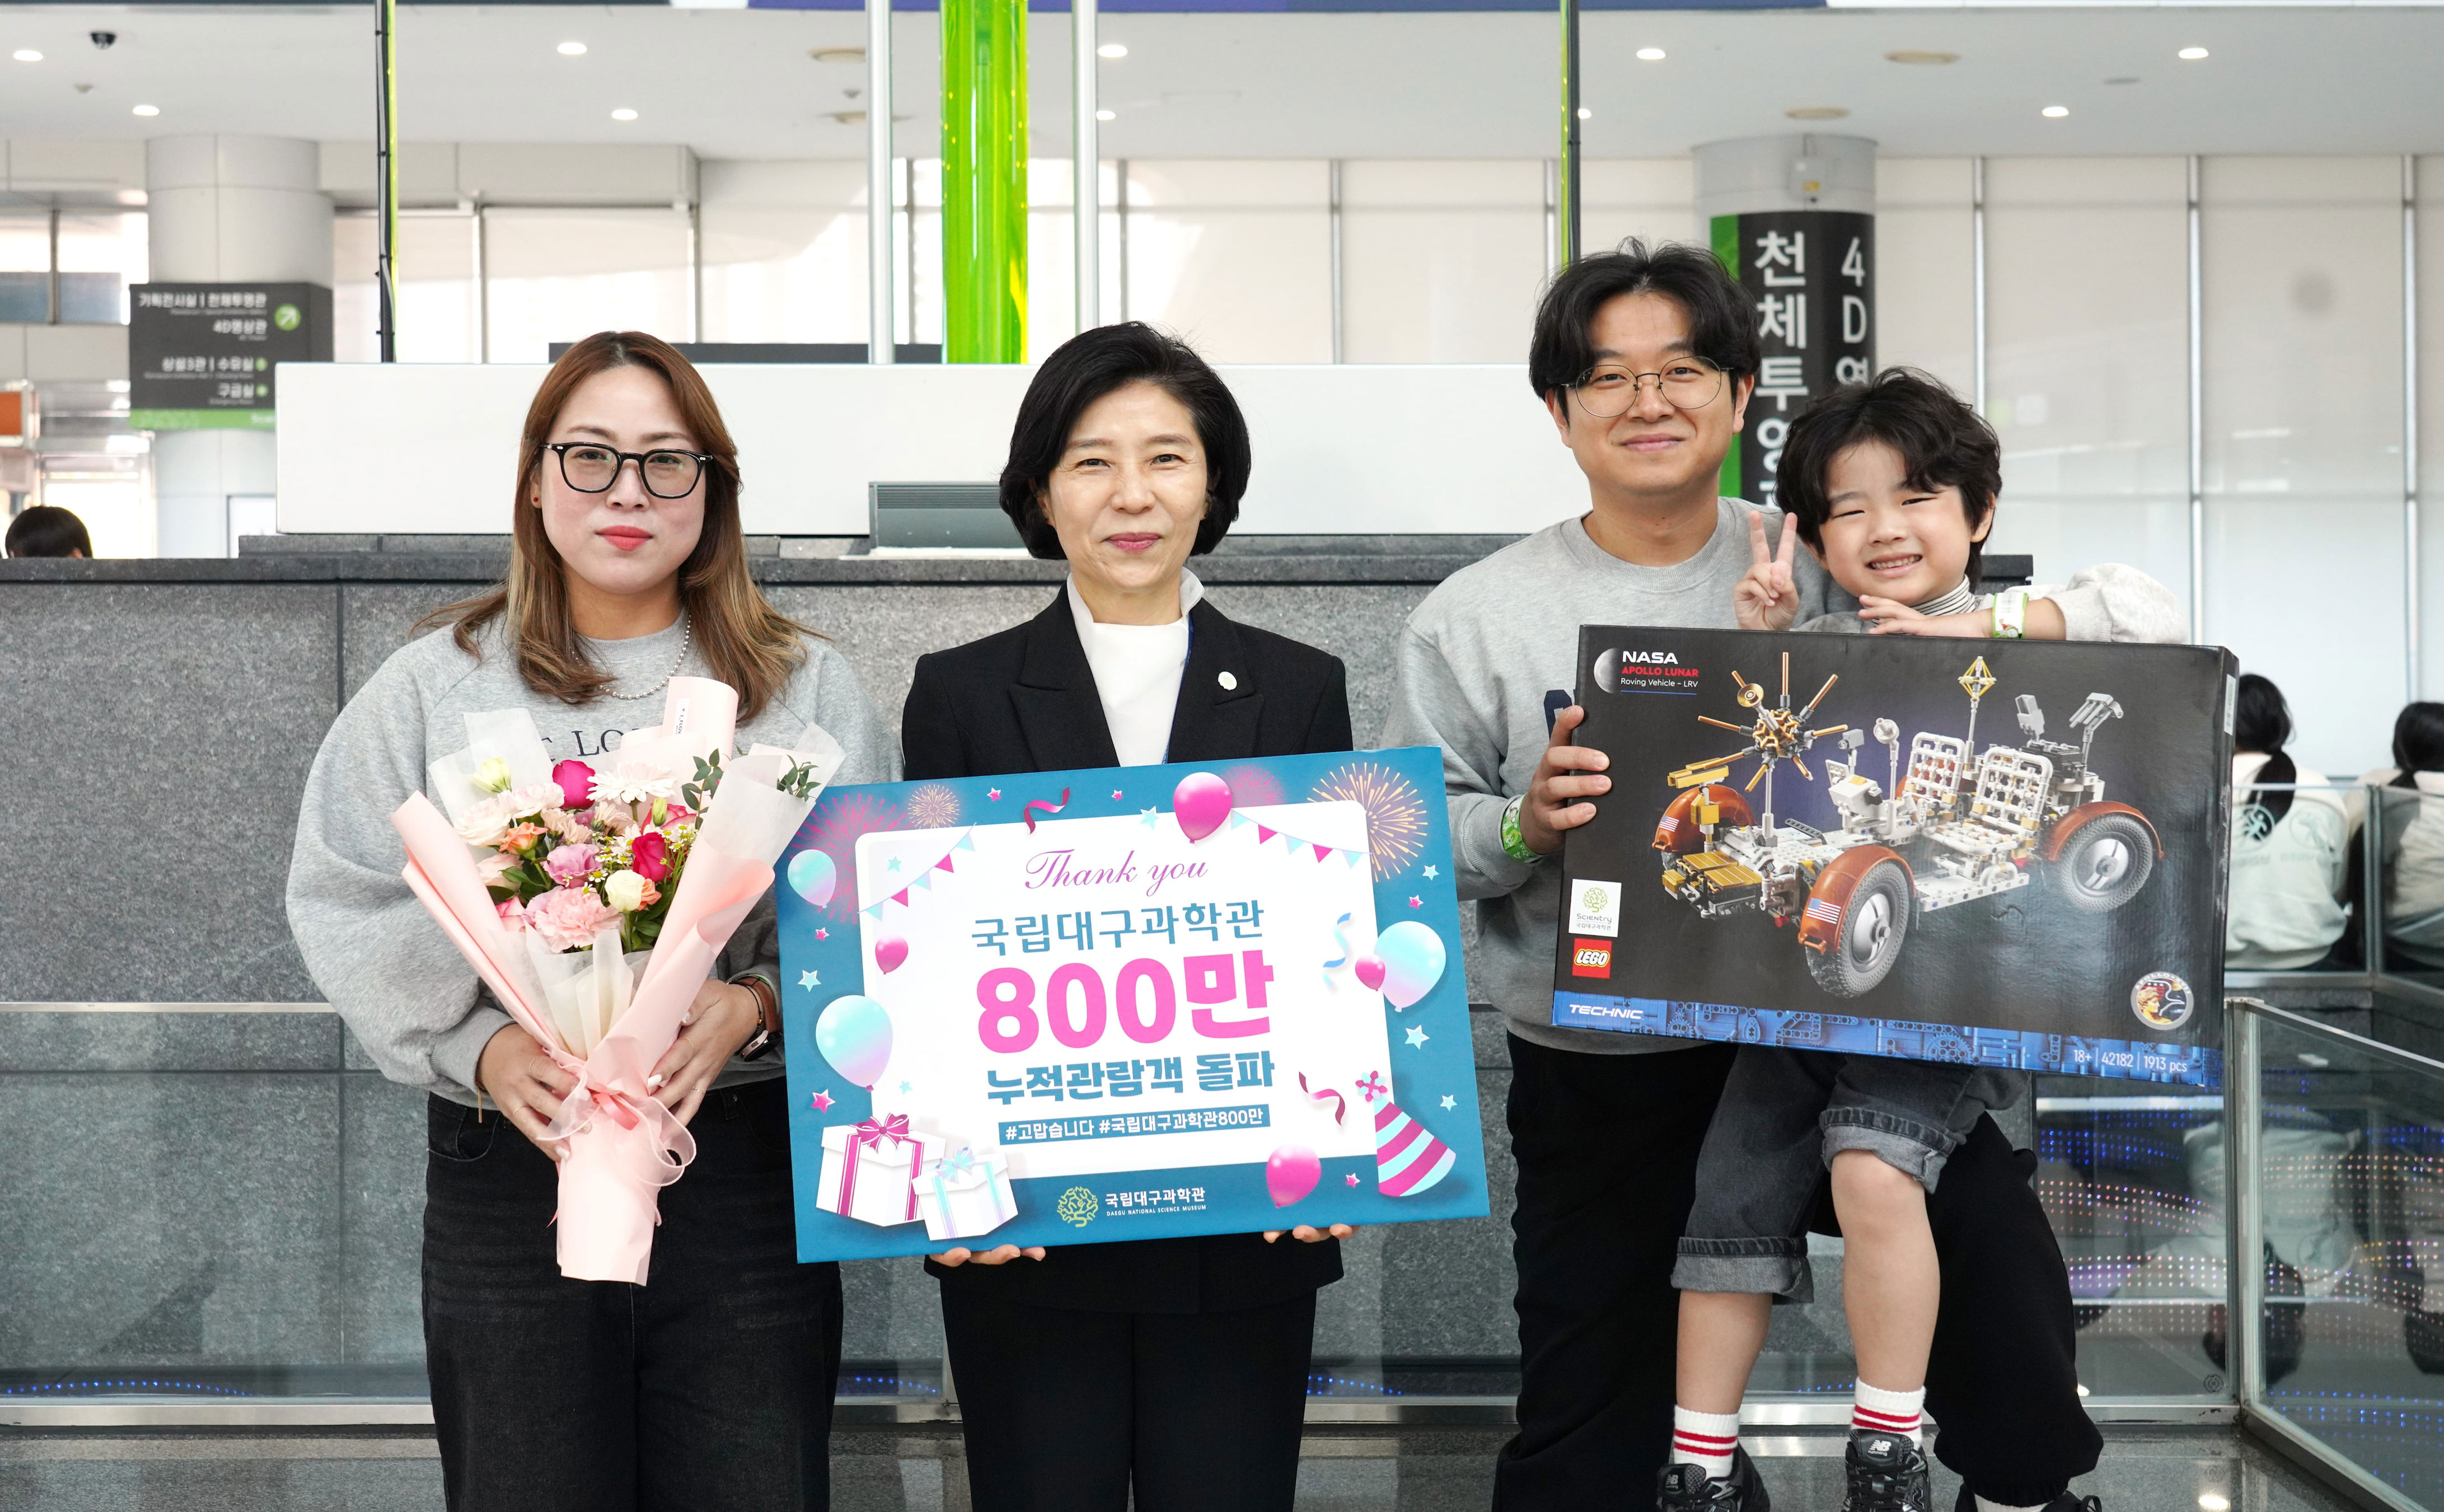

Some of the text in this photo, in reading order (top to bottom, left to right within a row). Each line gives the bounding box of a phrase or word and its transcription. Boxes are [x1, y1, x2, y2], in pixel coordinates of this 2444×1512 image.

[1754, 231, 1809, 509] 천체투
[1622, 650, 1678, 664] NASA
[1621, 677, 1646, 687] Roving
[1648, 678, 1675, 687] Vehicle
[1622, 666, 1699, 677] APOLLO LUNAR
[1024, 848, 1209, 897] Thank you
[972, 899, 1265, 956] 국립대구과학관
[1576, 923, 1612, 931] 국립대구과학관
[1575, 950, 1609, 967] LEGO
[976, 949, 1275, 1054] 800만
[1569, 1004, 1644, 1020] TECHNIC
[2073, 1050, 2188, 1074] 18+ 42182 1913 pcs
[987, 1050, 1275, 1106] 누적관람객 돌파
[1005, 1108, 1263, 1141] #고맙습니다 #국립대구과학관800만
[1104, 1187, 1206, 1209] 국립대구과학관
